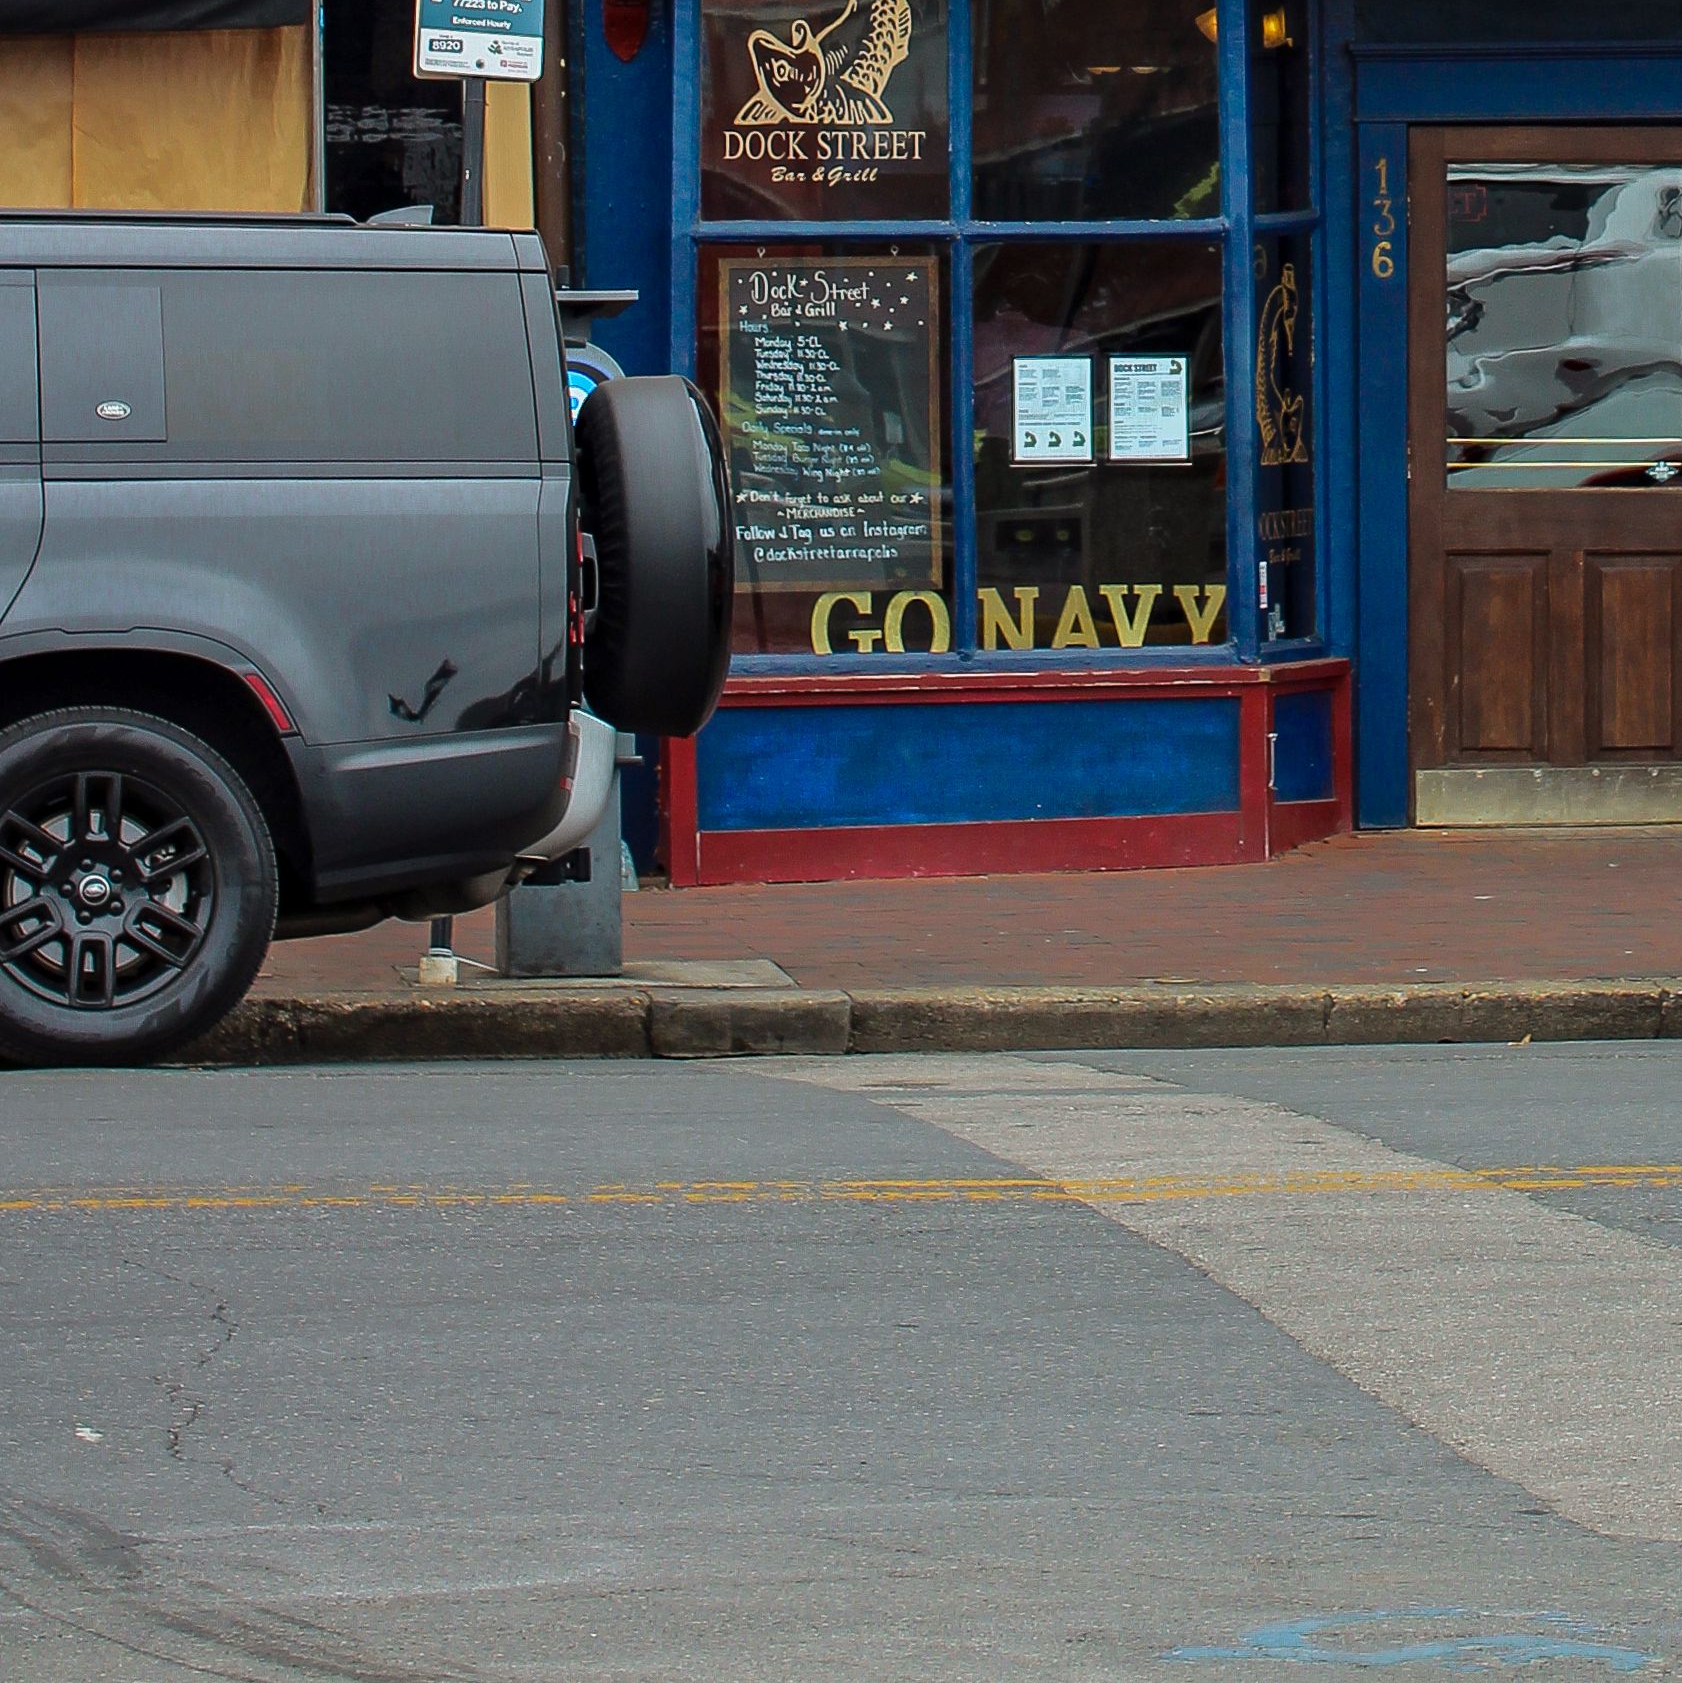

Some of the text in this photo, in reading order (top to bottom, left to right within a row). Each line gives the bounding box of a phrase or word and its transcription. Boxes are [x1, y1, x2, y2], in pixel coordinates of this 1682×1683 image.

[487, 0, 498, 10] to
[499, 0, 523, 13] Pay.
[452, 16, 512, 30] Enforced Hourly
[432, 40, 460, 50] 8920
[723, 130, 926, 161] DOCK STREET
[771, 166, 879, 187] Bar & Grill
[1371, 158, 1395, 280] 136
[810, 270, 870, 304] Street
[771, 303, 792, 317] Bar
[805, 302, 835, 317] Grill
[754, 336, 792, 353] Monday
[754, 348, 790, 361] Tuesday
[754, 360, 804, 375] Wednesday
[754, 370, 794, 385] Thursday
[755, 381, 785, 396] Friday
[754, 393, 792, 408] Saturday
[754, 404, 788, 419] Sunday
[741, 421, 769, 439] Daily
[773, 422, 813, 435] Specials
[752, 440, 788, 454] Monday
[784, 492, 812, 508] forget
[817, 492, 829, 503] to
[858, 491, 884, 503] about
[890, 493, 908, 503] our
[735, 525, 776, 541] Follow
[791, 524, 812, 544] Tag
[819, 526, 835, 538] us
[840, 526, 857, 537] on
[863, 520, 928, 541] Instagram
[811, 584, 1227, 655] GO NAVY
